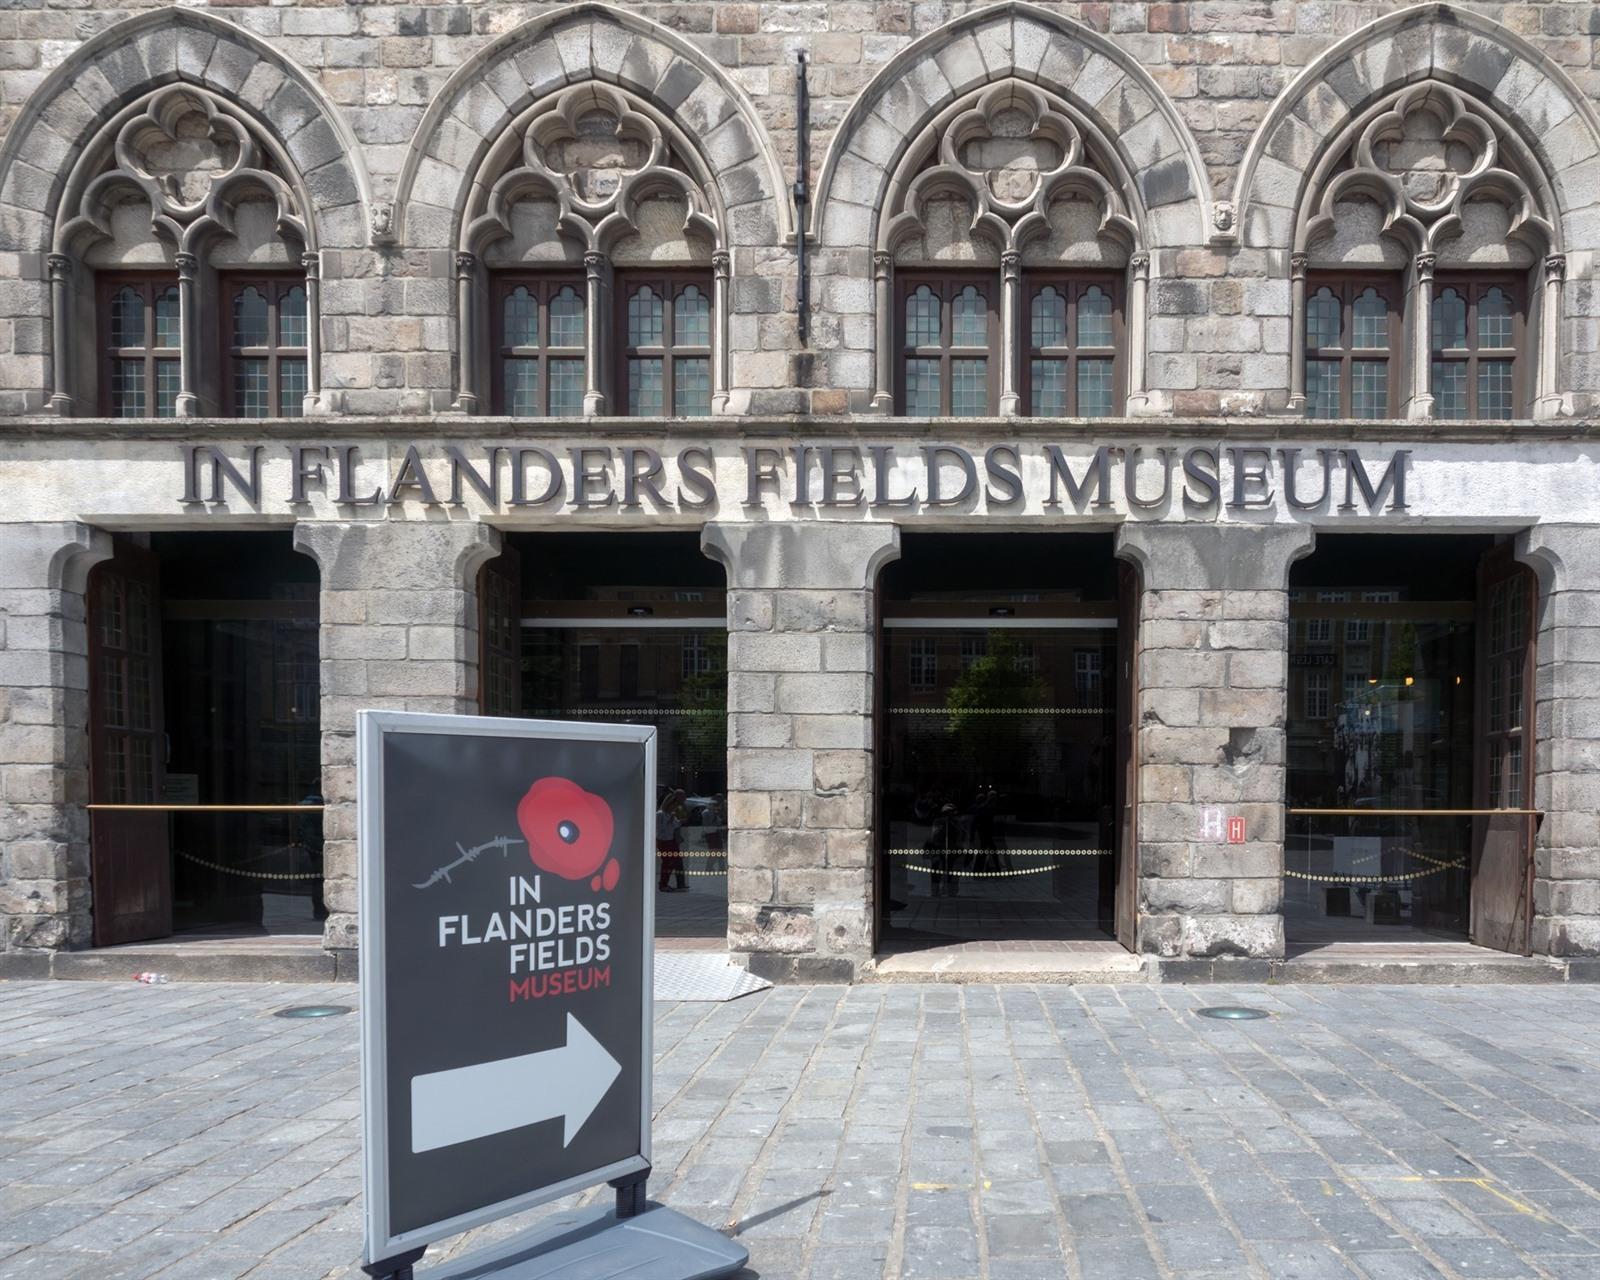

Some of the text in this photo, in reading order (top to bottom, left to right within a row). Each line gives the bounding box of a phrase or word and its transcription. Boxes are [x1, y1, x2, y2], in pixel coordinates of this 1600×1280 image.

[177, 444, 1413, 509] IN FLANDERS FIELDS MUSEUM
[1232, 821, 1241, 839] H
[509, 875, 541, 905] IN
[438, 902, 611, 947] FLANDERS
[509, 933, 611, 974] FIELDS
[509, 965, 611, 1003] MUSEUM
